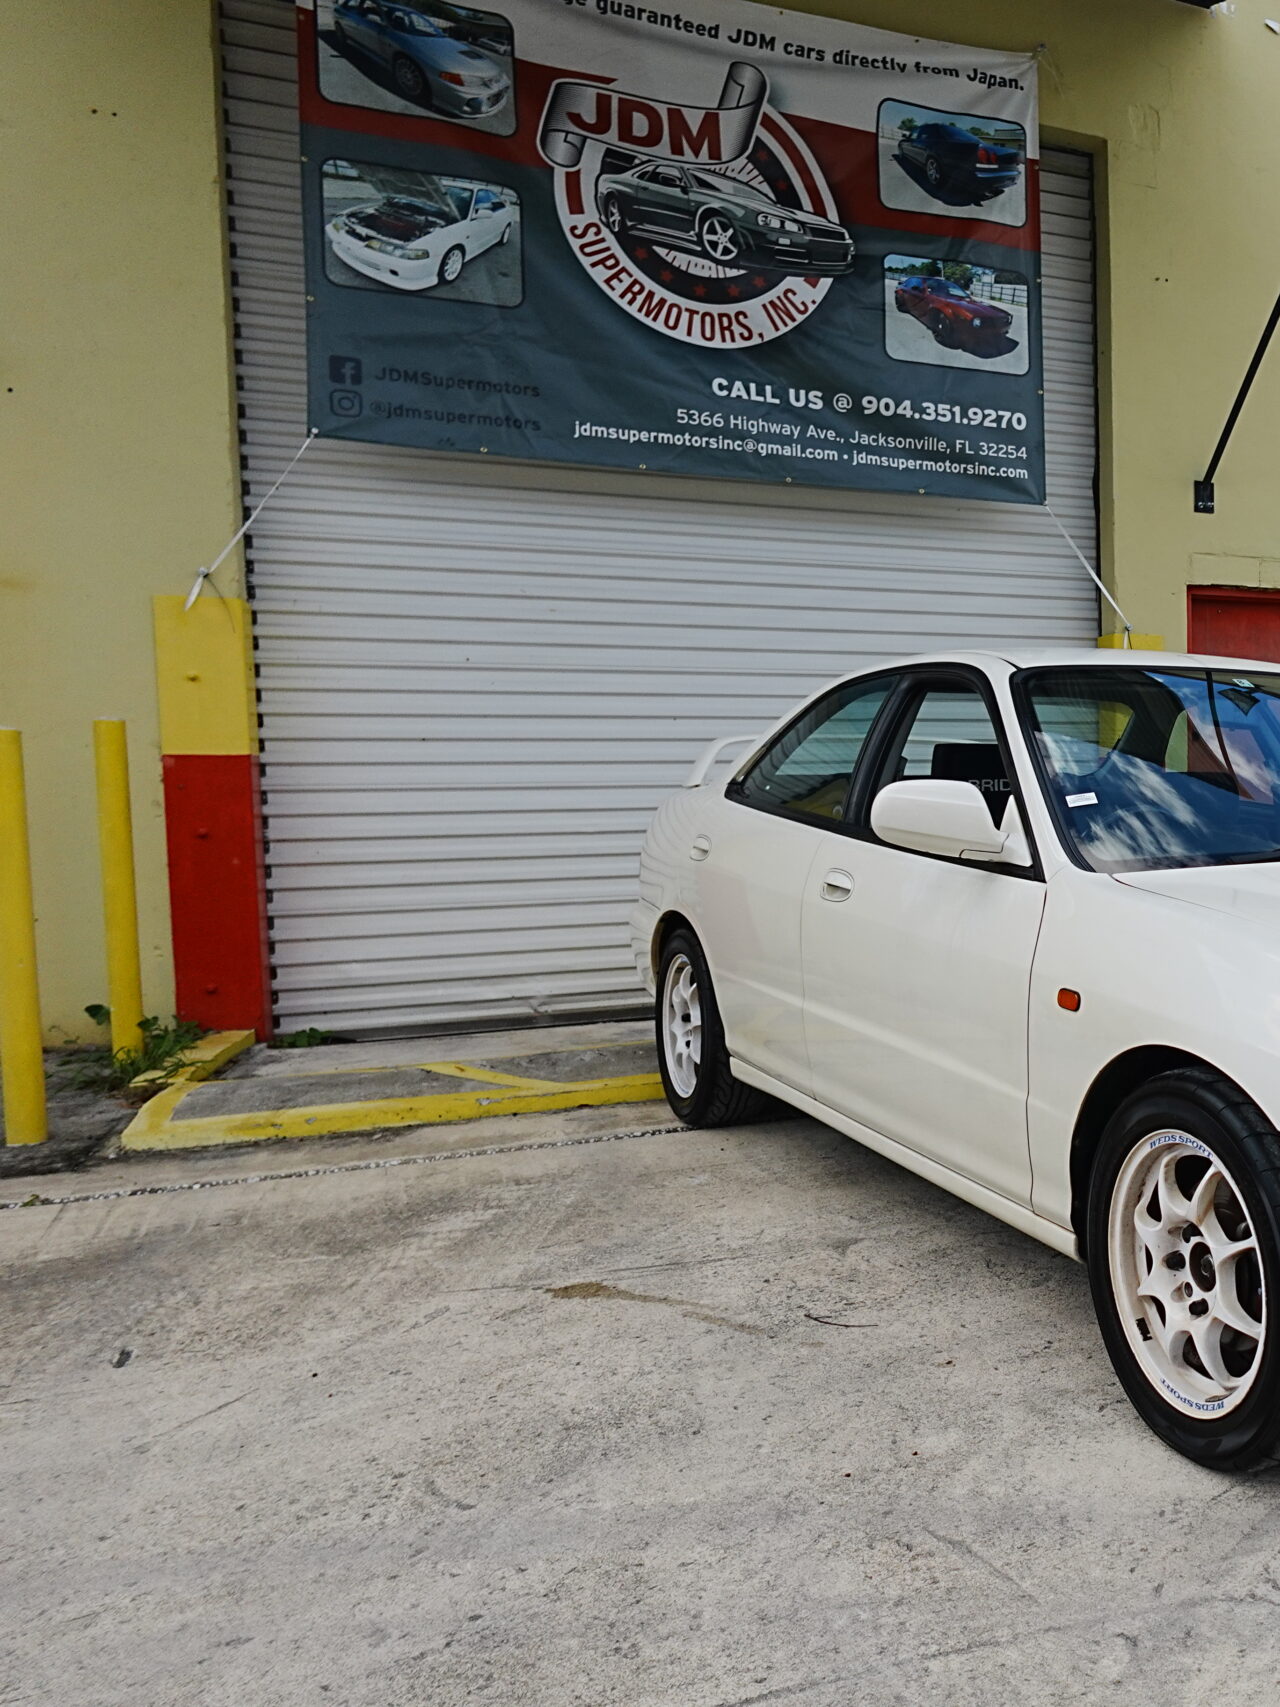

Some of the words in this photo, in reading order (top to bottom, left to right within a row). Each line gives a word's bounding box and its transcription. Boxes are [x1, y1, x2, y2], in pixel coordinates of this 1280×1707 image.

[596, 0, 720, 40] guaranteed
[728, 28, 777, 51] JDM
[783, 41, 825, 62] cars
[832, 49, 907, 73] directly
[914, 61, 960, 78] from
[966, 68, 1025, 91] Japan.
[566, 91, 723, 161] JDM
[570, 221, 764, 343] SUPERMOTORS,
[762, 288, 817, 333] INC.
[374, 367, 541, 398] JDMSupermotors
[712, 377, 781, 404] CALL
[788, 388, 824, 410] US
[832, 393, 853, 413] @
[861, 395, 1027, 431] 904.351.9270
[369, 400, 542, 432] @jdmsupermotors
[676, 408, 724, 428] 5366
[730, 415, 801, 439] Highway
[806, 424, 844, 444] Ave.,
[849, 430, 950, 454] Jacksonville,
[956, 439, 975, 455] FL
[979, 442, 1028, 460] 32254
[573, 420, 838, 461] jdmsupermotorsinc@gmail.com
[851, 449, 1028, 480] jdmsupermotorsinc.com
